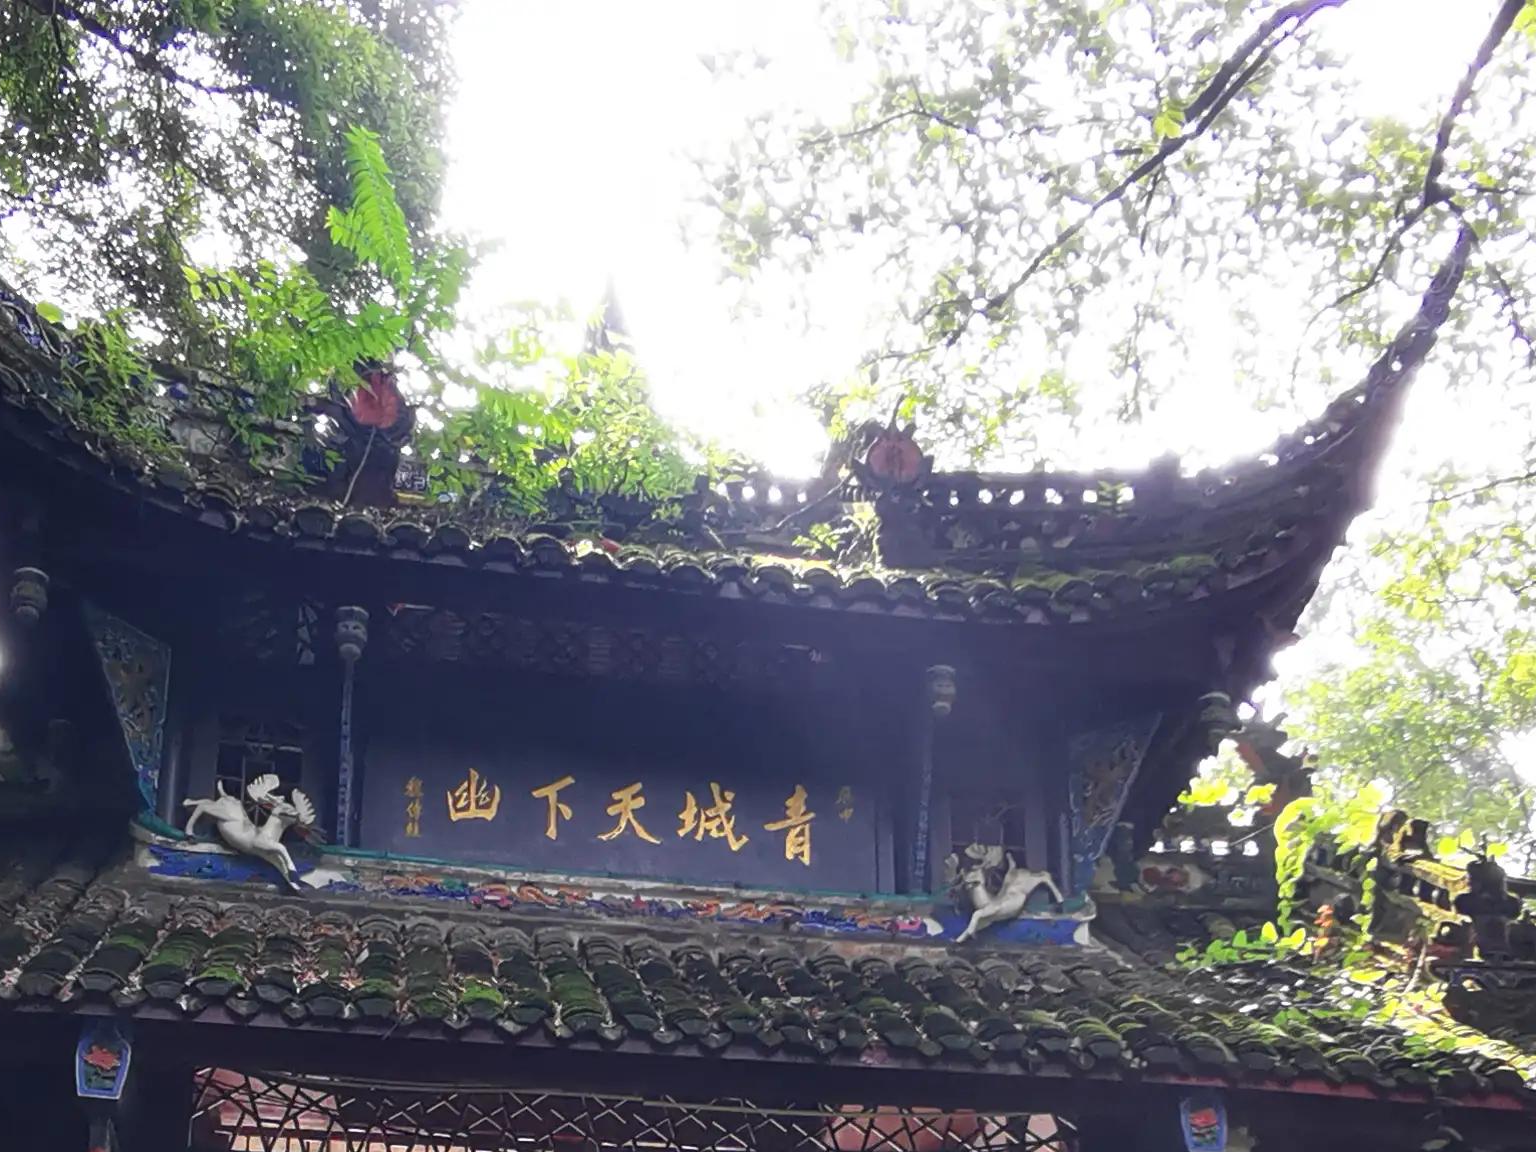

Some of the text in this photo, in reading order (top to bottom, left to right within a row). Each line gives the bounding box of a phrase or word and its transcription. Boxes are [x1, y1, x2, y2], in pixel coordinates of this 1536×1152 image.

[447, 768, 816, 866] 青城天下幽
